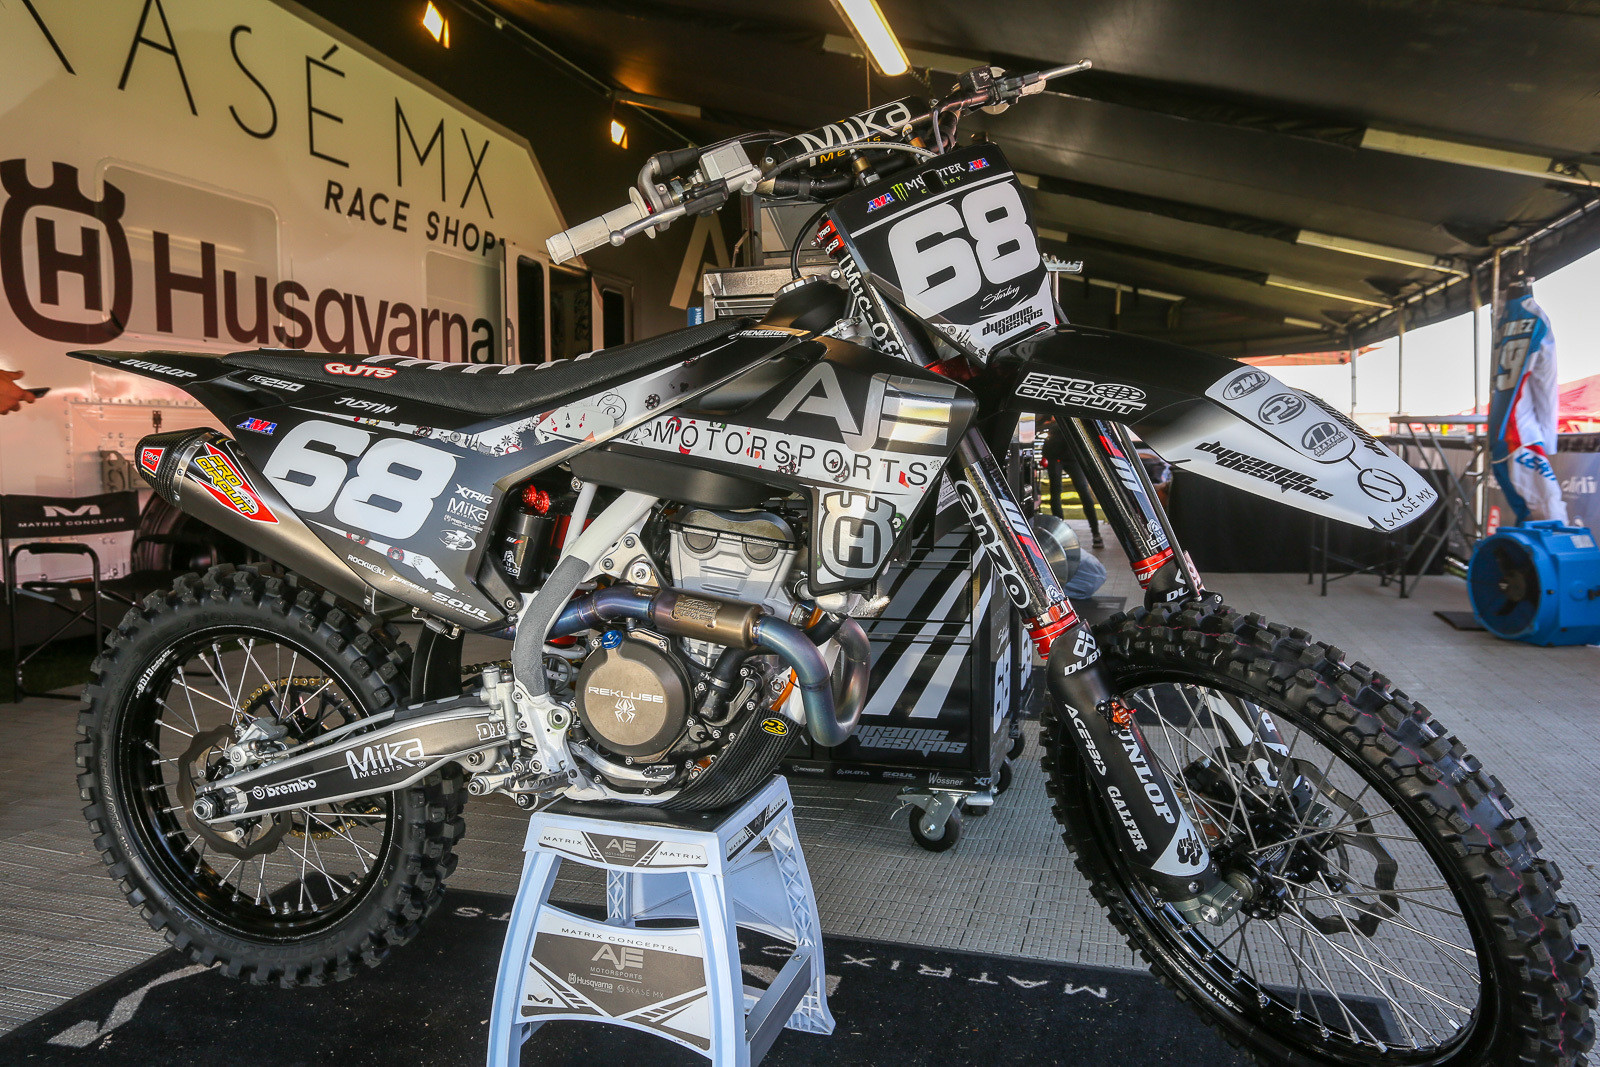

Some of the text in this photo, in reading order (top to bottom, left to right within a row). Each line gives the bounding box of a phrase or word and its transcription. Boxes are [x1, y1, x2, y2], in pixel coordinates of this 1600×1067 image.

[22, 0, 493, 218] ASÉ MX
[796, 102, 912, 167] Mika
[968, 158, 990, 172] AMA
[325, 180, 410, 233] RACE
[867, 192, 895, 211] AMA
[888, 179, 1041, 320] 68
[153, 231, 495, 364] Husqvarna
[119, 358, 198, 379] DUNLOP
[324, 361, 397, 379] GUTS
[246, 374, 306, 392] FC250
[1021, 371, 1095, 394] PRO
[334, 396, 397, 414] JUSTIN
[1015, 383, 1147, 415] CIRCUIT
[236, 417, 278, 435] AMA
[652, 420, 929, 487] MOTORSPORTS
[208, 455, 243, 487] PRO
[262, 419, 462, 540] 68
[195, 457, 255, 514] CIRCUIT
[455, 483, 494, 505] XTRIG
[1418, 487, 1435, 505] MX
[447, 497, 490, 523] Mika
[65, 517, 125, 526] CONCEPTS
[954, 480, 1030, 609] enzo
[431, 592, 491, 622] SOUL
[588, 686, 664, 703] REKLUSE
[854, 724, 950, 742] ynamic
[1064, 703, 1108, 777] ACERBIS
[860, 736, 968, 758] designs
[345, 738, 425, 780] Mika
[359, 764, 403, 779] Metals
[1117, 729, 1176, 824] UNLOP
[266, 778, 317, 797] brembo
[1106, 785, 1148, 852] GALFER
[543, 835, 583, 845] MATRIX
[605, 838, 636, 852] AJE
[729, 835, 747, 851] MATRIX
[659, 851, 702, 860] MATRIX
[561, 927, 602, 940] MATRIX
[591, 943, 644, 970] AJE
[576, 976, 613, 991] Husqvarna
[590, 966, 643, 980] MOTORSPORTS
[841, 953, 1107, 998] MATRIX
[652, 990, 664, 999] MX
